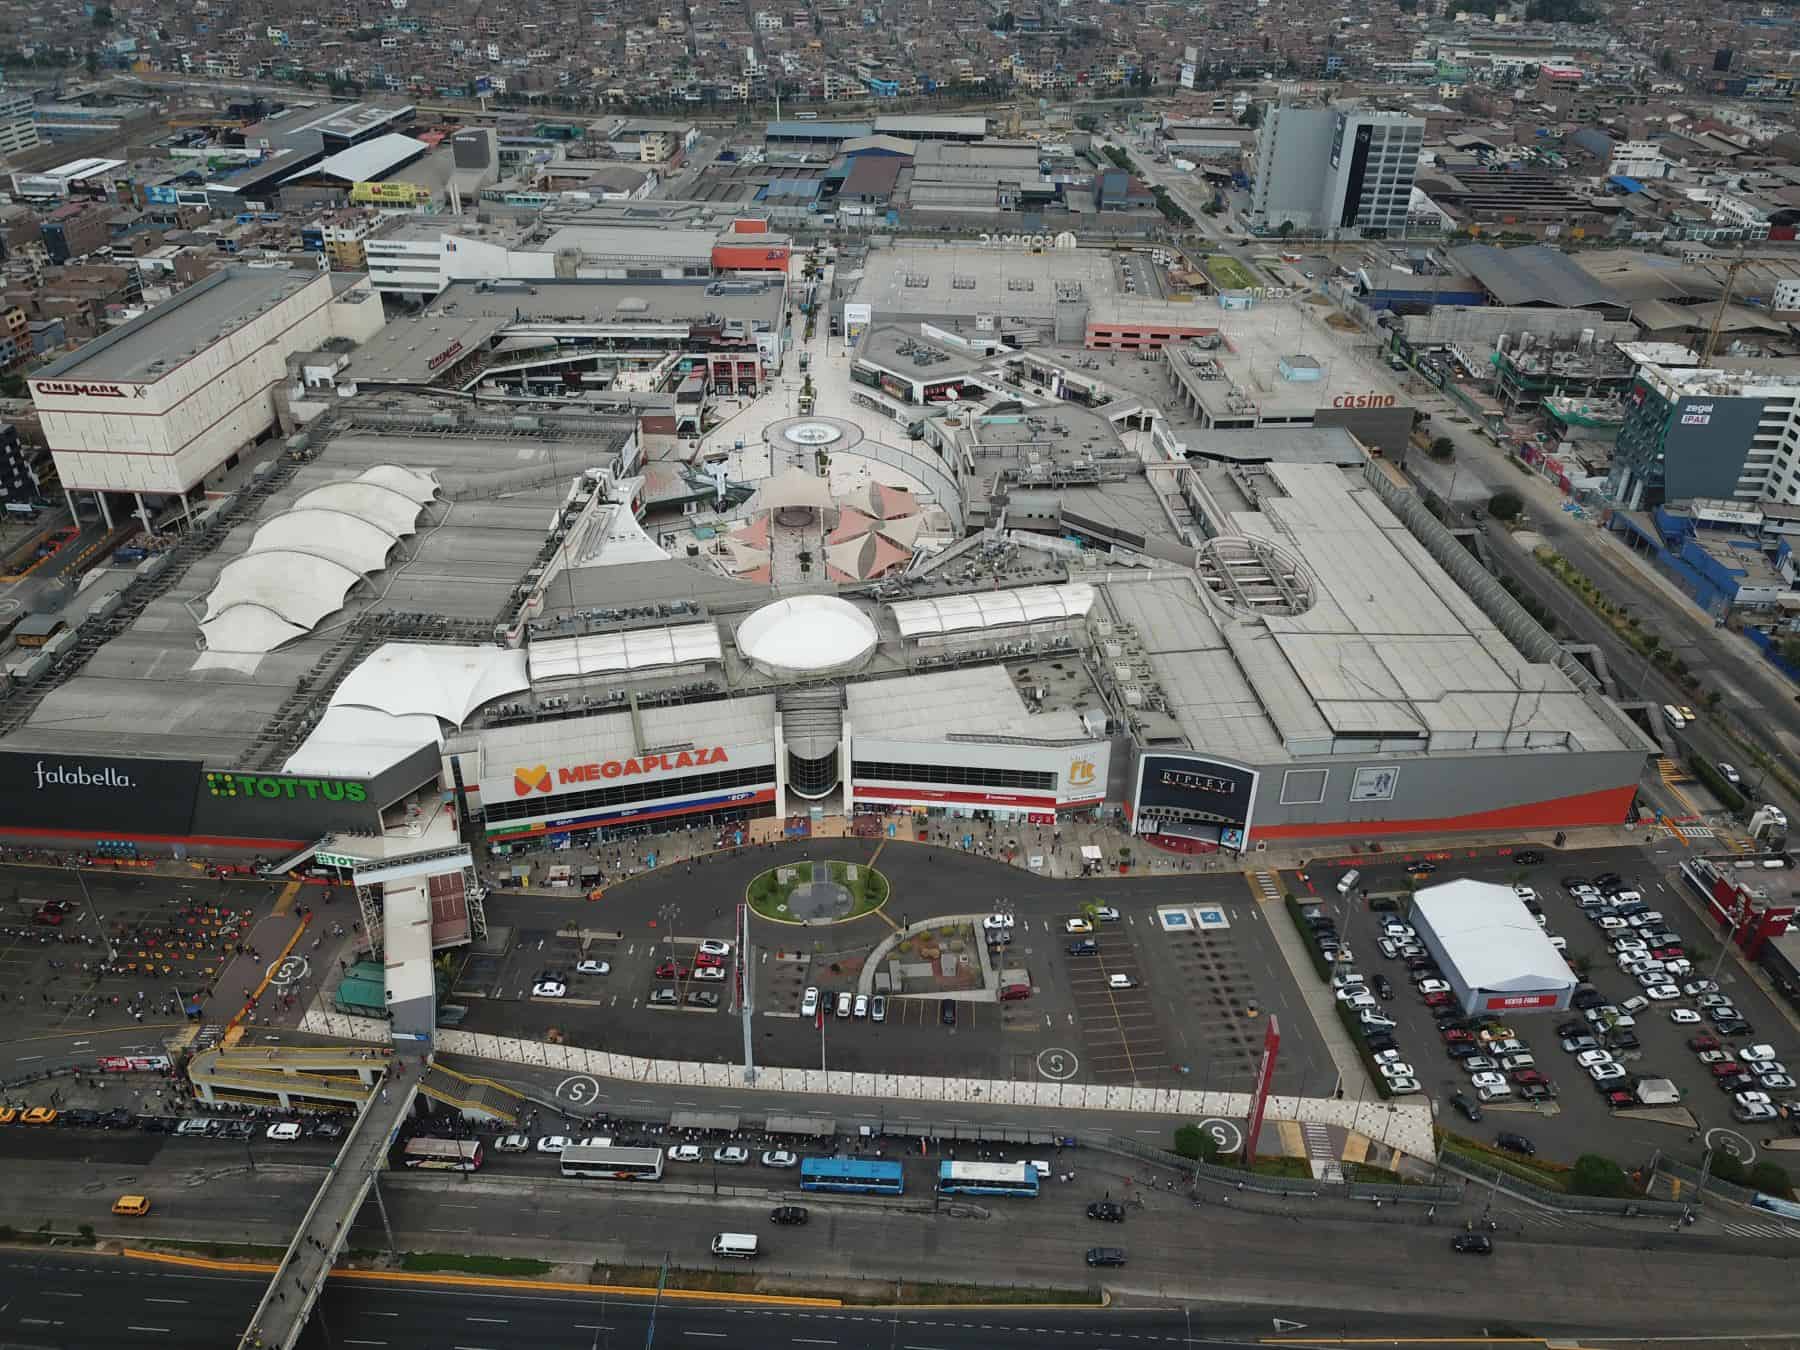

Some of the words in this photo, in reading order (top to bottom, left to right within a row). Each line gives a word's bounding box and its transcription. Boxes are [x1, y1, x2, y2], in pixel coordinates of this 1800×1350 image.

[36, 382, 128, 398] CINEMARK
[1333, 390, 1395, 408] casino
[558, 746, 730, 785] MEGAPLAZA
[237, 775, 368, 802] TOTTUS
[1162, 771, 1227, 790] RIPLEY
